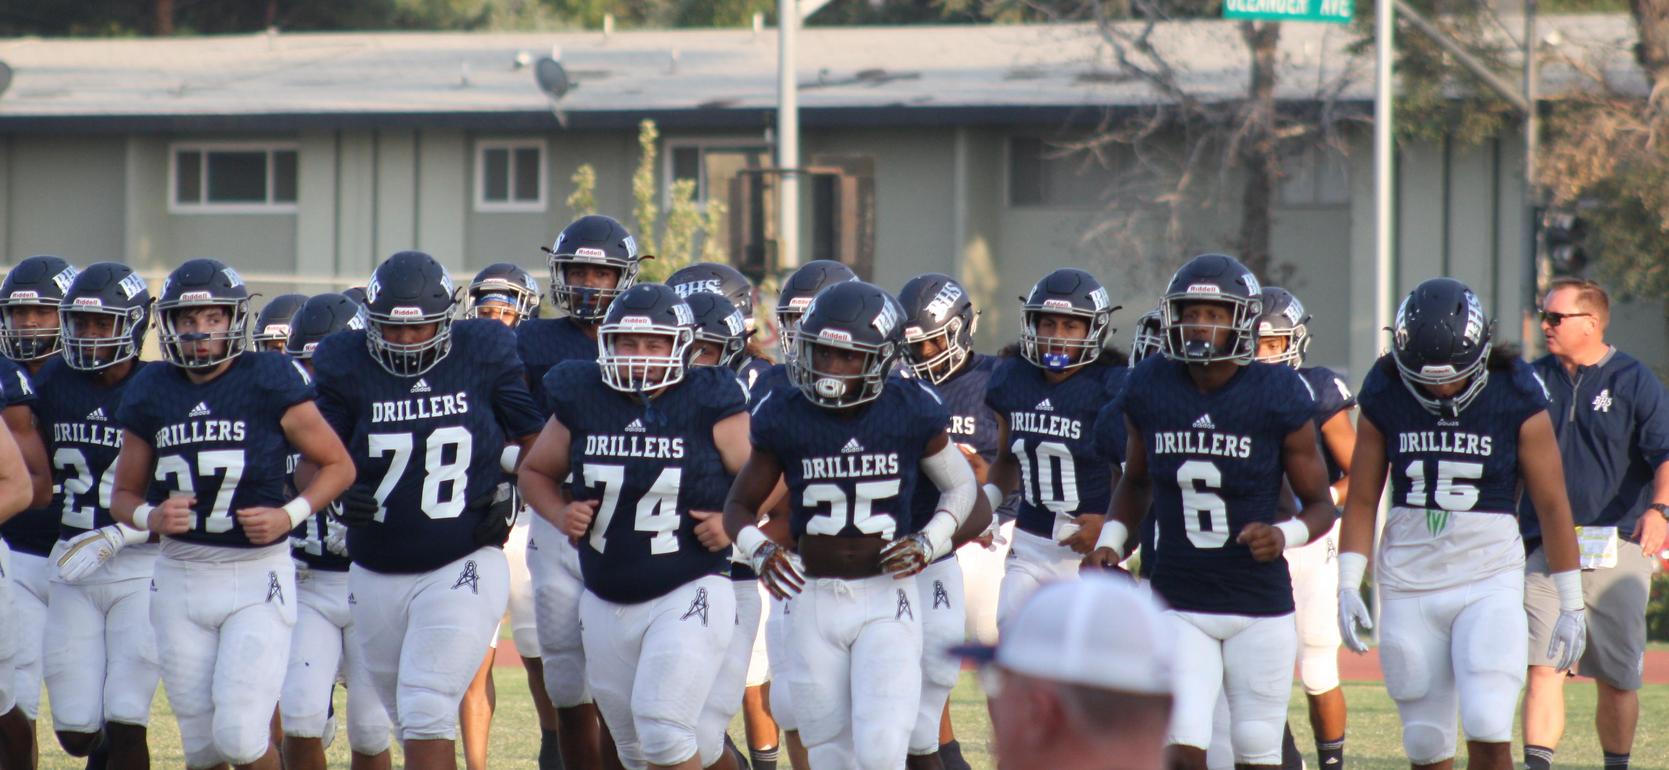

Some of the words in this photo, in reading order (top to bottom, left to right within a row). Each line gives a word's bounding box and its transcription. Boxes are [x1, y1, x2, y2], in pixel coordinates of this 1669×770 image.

[674, 279, 725, 299] BHS
[371, 392, 469, 423] DRILLERS
[54, 423, 124, 448] DRILLER
[155, 420, 246, 448] DRILLERS
[1010, 411, 1082, 440] DRILLERS
[584, 434, 685, 460] DRILLERS
[1155, 431, 1252, 459] DRILLERS
[1399, 431, 1492, 457] DRILLERS
[367, 425, 473, 524] 78
[802, 453, 899, 480] DRILLERS
[1010, 438, 1080, 512] 10
[582, 463, 683, 556] 74
[802, 479, 901, 541] 25
[1176, 459, 1230, 549] 6
